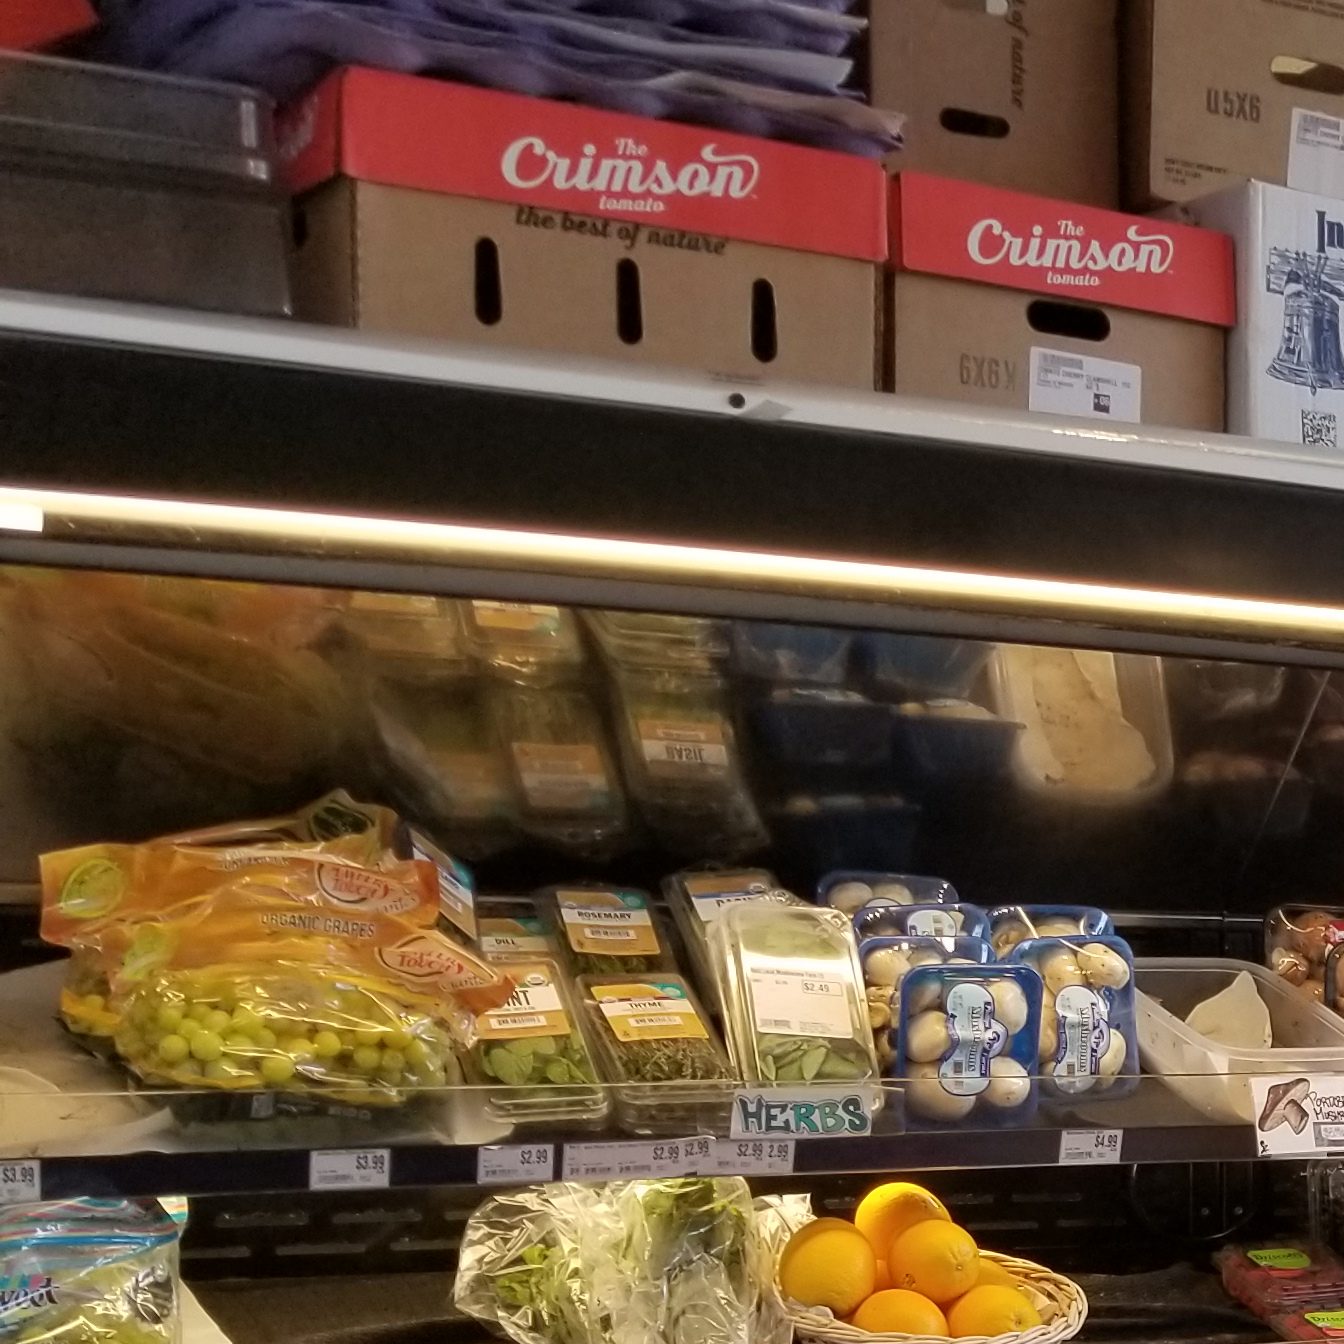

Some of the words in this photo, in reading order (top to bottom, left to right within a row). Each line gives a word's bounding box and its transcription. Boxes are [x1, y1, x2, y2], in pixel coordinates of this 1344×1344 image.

[616, 138, 648, 157] The
[502, 136, 759, 198] Crimson
[599, 195, 666, 213] tomato
[515, 205, 556, 230] the
[560, 211, 611, 239] best
[616, 223, 641, 250] of
[647, 227, 729, 255] nature
[1057, 220, 1084, 236] The
[967, 219, 1174, 273] Crimson
[1046, 271, 1100, 286] tomato
[577, 910, 632, 920] ROSEMARY
[261, 911, 320, 931] ORGANIC
[323, 915, 375, 939] GRAPES
[504, 989, 530, 1007] INT
[629, 1001, 663, 1009] THYME
[738, 1095, 870, 1135] HERBS
[1095, 1134, 1118, 1148] $4.99
[521, 1149, 548, 1165] $2.99
[653, 1146, 680, 1161] $2.99
[737, 1144, 763, 1158] $2.99
[356, 1155, 385, 1170] $3.99
[3, 1167, 35, 1183] $3.99
